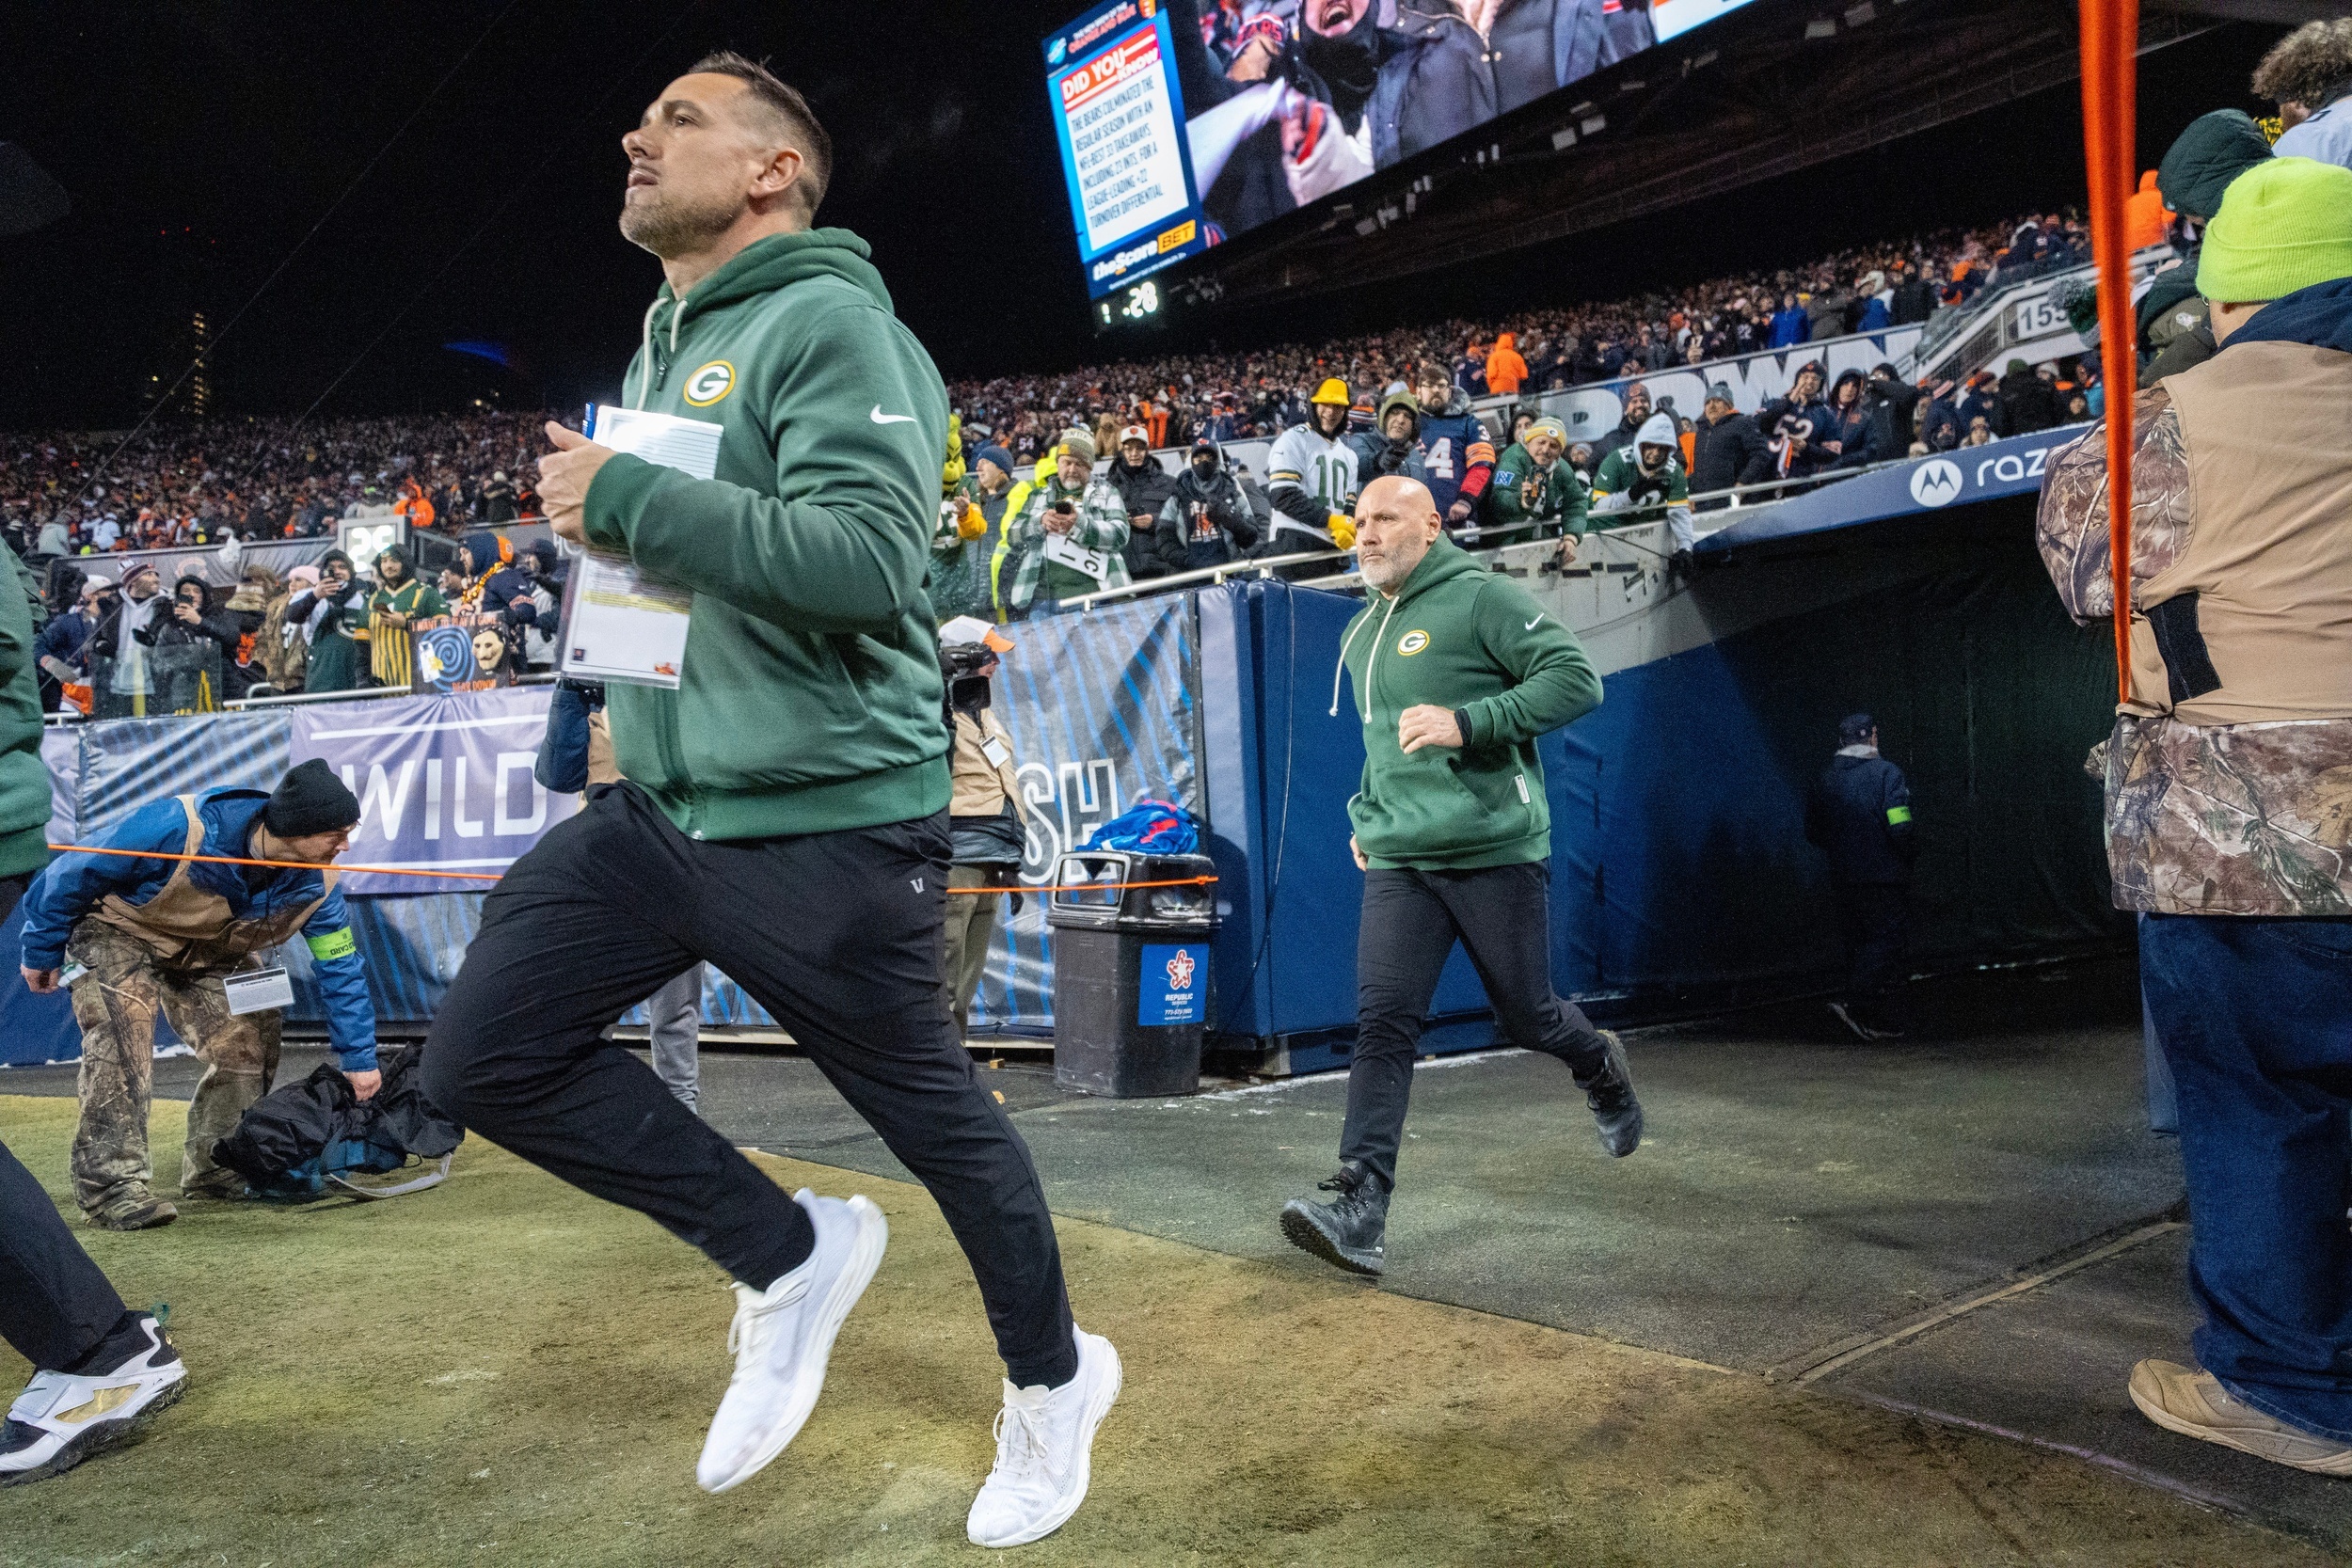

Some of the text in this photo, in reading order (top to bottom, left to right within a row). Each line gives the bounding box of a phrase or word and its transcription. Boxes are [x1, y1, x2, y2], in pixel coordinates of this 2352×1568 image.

[1061, 71, 1090, 101] DID
[1091, 47, 1126, 82] YOU
[1116, 47, 1159, 81] KNOW
[1072, 75, 1154, 133] THE BEARS CULMINATED THE
[1075, 99, 1153, 151] REGULAR SEASON WITH AN
[1083, 164, 1114, 190] INCLUDING
[1139, 144, 1152, 161] FOR
[1087, 174, 1136, 211] LEAGUE-LEADING
[1090, 182, 1164, 228] TURNOVER DIFFERENTIAL
[1093, 239, 1158, 281] theScore
[1162, 224, 1192, 249] BET
[685, 363, 733, 404] G
[1312, 454, 1349, 509] 10
[1400, 631, 1428, 655] G
[341, 751, 548, 844] WILD
[330, 942, 349, 957] CARD
[1165, 992, 1194, 1002] REPUBLIC
